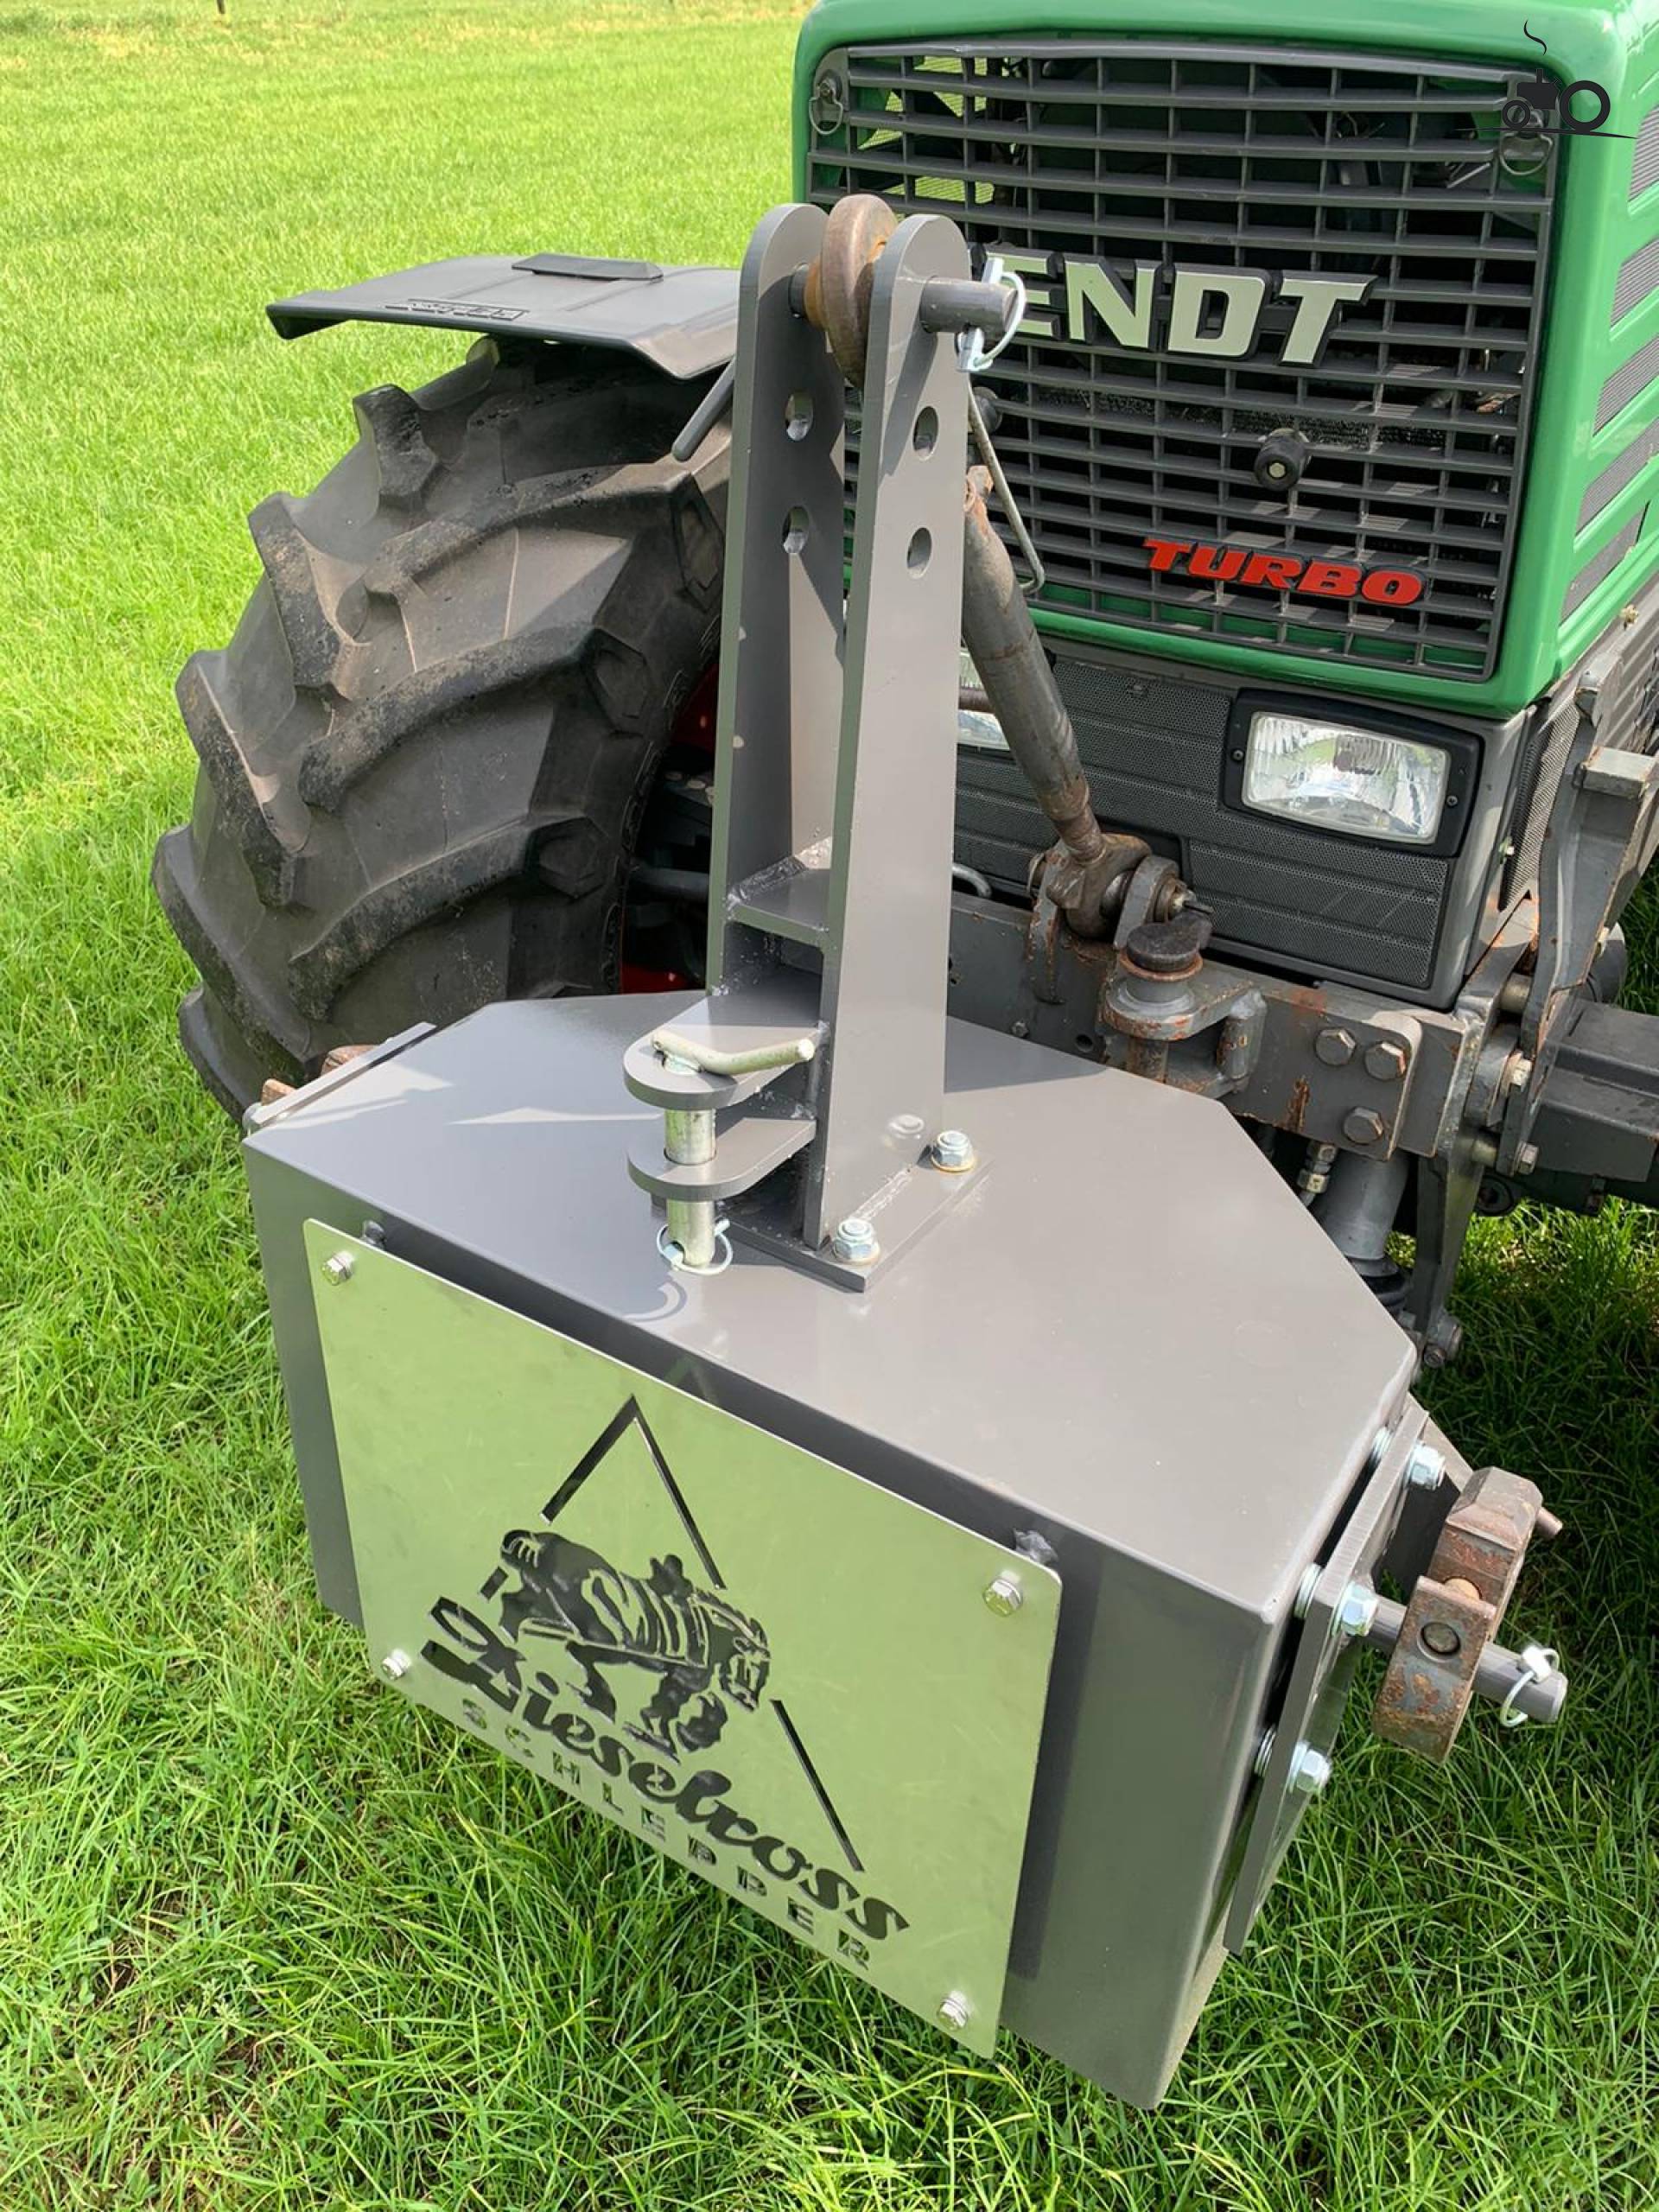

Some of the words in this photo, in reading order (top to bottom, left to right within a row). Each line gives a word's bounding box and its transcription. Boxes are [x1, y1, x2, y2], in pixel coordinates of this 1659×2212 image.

[975, 249, 1374, 365] ENDT
[1143, 538, 1422, 606] TURBO
[421, 1595, 910, 1941] Dieselross
[461, 1698, 870, 1971] SCHLEPPER
